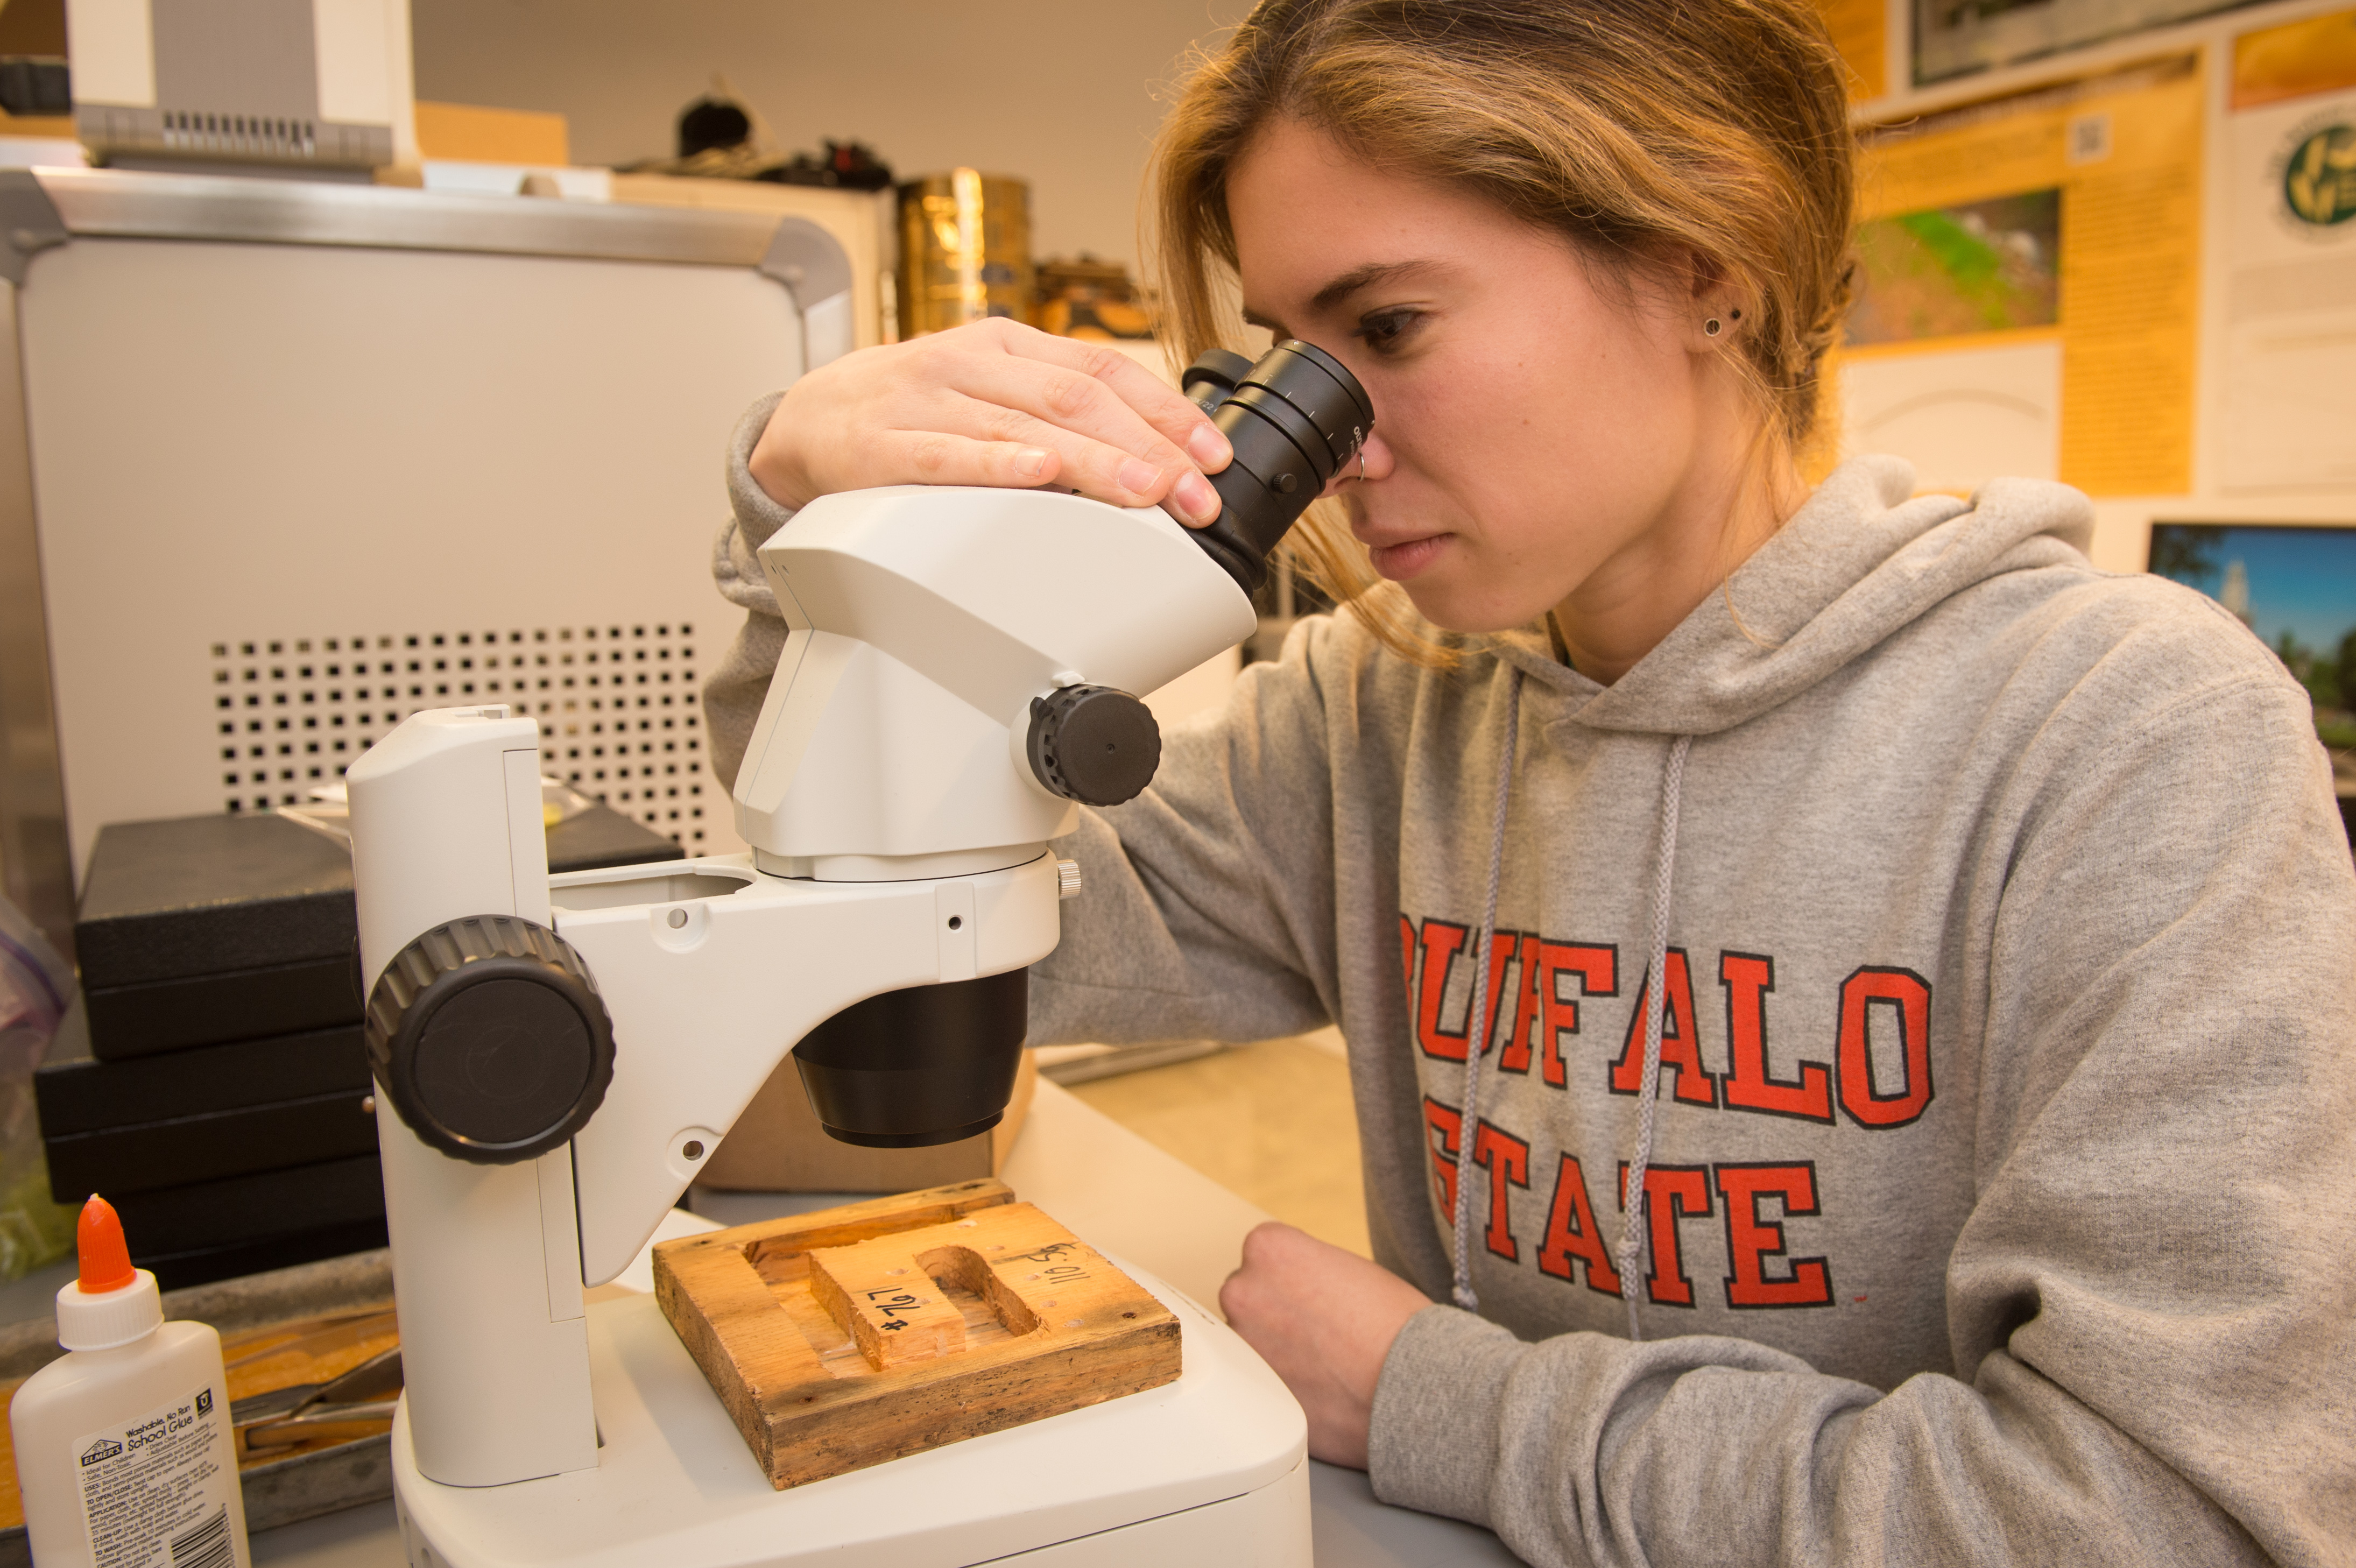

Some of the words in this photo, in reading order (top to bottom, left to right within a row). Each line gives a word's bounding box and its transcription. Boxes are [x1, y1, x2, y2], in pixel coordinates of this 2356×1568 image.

[1423, 1093, 1835, 1309] STATE
[167, 1412, 177, 1421] No
[178, 1405, 190, 1416] Run
[128, 1425, 166, 1451] School
[168, 1416, 193, 1432] Glue
[150, 1440, 177, 1455] Adjustable
[178, 1432, 194, 1443] Before
[164, 1434, 177, 1443] Clear
[84, 1445, 122, 1465] ELMER'S
[86, 1466, 101, 1475] Ideal
[112, 1453, 135, 1465] Children
[84, 1482, 101, 1492] USES:
[102, 1476, 118, 1486] Bonds
[119, 1470, 132, 1479] most
[133, 1463, 151, 1474] porous
[103, 1461, 131, 1475] Non-Toxic
[101, 1484, 111, 1492] and
[112, 1472, 144, 1488] semi-porous
[105, 1496, 115, 1505] and
[116, 1492, 129, 1501] store
